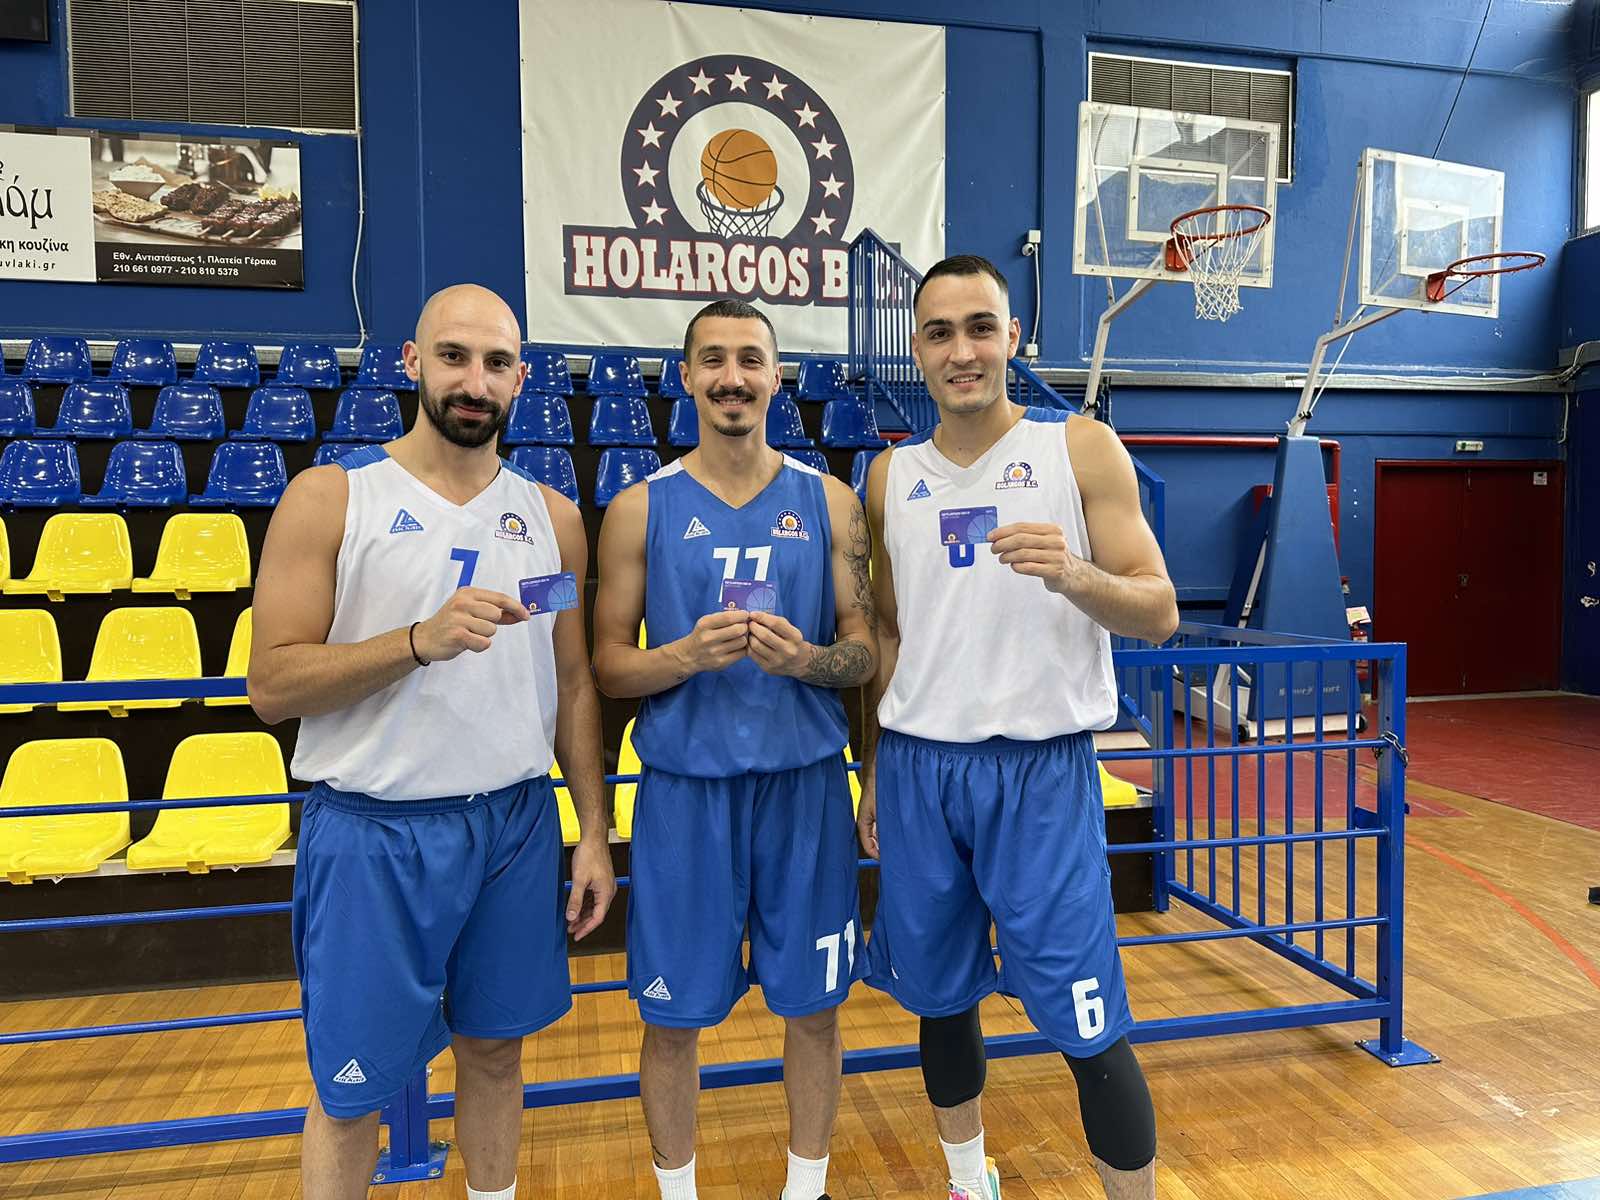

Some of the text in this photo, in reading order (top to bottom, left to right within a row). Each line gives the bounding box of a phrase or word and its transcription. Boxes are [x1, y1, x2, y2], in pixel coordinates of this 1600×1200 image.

[0, 175, 53, 229] άμ
[19, 238, 69, 253] κουζίνα
[113, 252, 133, 261] Εθν.
[135, 253, 195, 264] Αντιστάσεως
[207, 255, 242, 265] Πλατεία
[244, 256, 277, 266] Γέρακα
[572, 235, 810, 297] HOLARGOS
[113, 264, 130, 272] 210
[132, 265, 148, 273] 661
[151, 265, 172, 274] 0977
[181, 266, 197, 275] 210
[199, 267, 215, 276] 810
[217, 268, 239, 276] 5378
[450, 548, 480, 589] 7
[712, 546, 772, 602] 77
[1072, 977, 1105, 1039] 6
